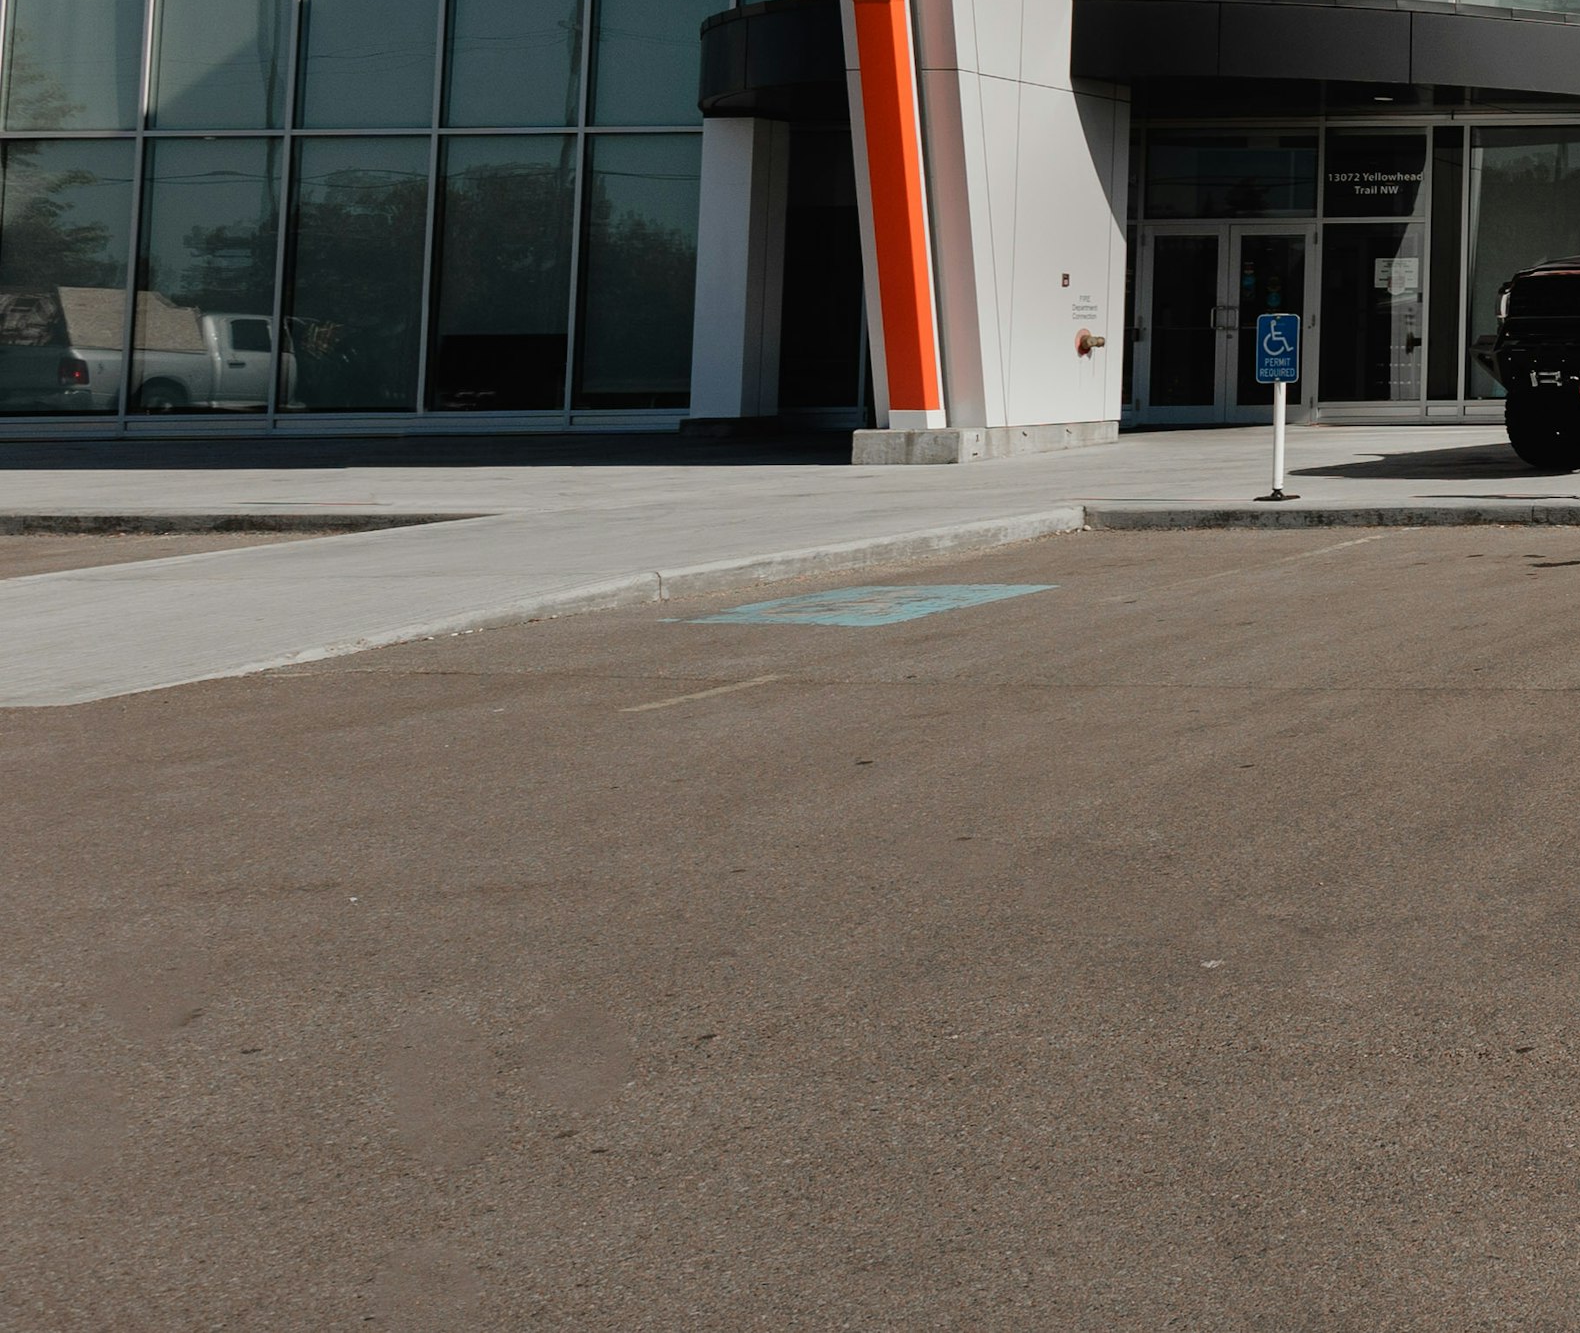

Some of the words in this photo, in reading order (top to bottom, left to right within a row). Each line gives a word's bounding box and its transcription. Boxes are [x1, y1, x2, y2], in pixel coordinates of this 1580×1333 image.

[1328, 173, 1360, 182] 13072
[1362, 171, 1424, 182] Yellowhead
[1354, 185, 1378, 195] Trail
[1380, 185, 1400, 195] NW
[1264, 357, 1291, 367] PERMIT
[1259, 367, 1296, 378] REQUIRED
